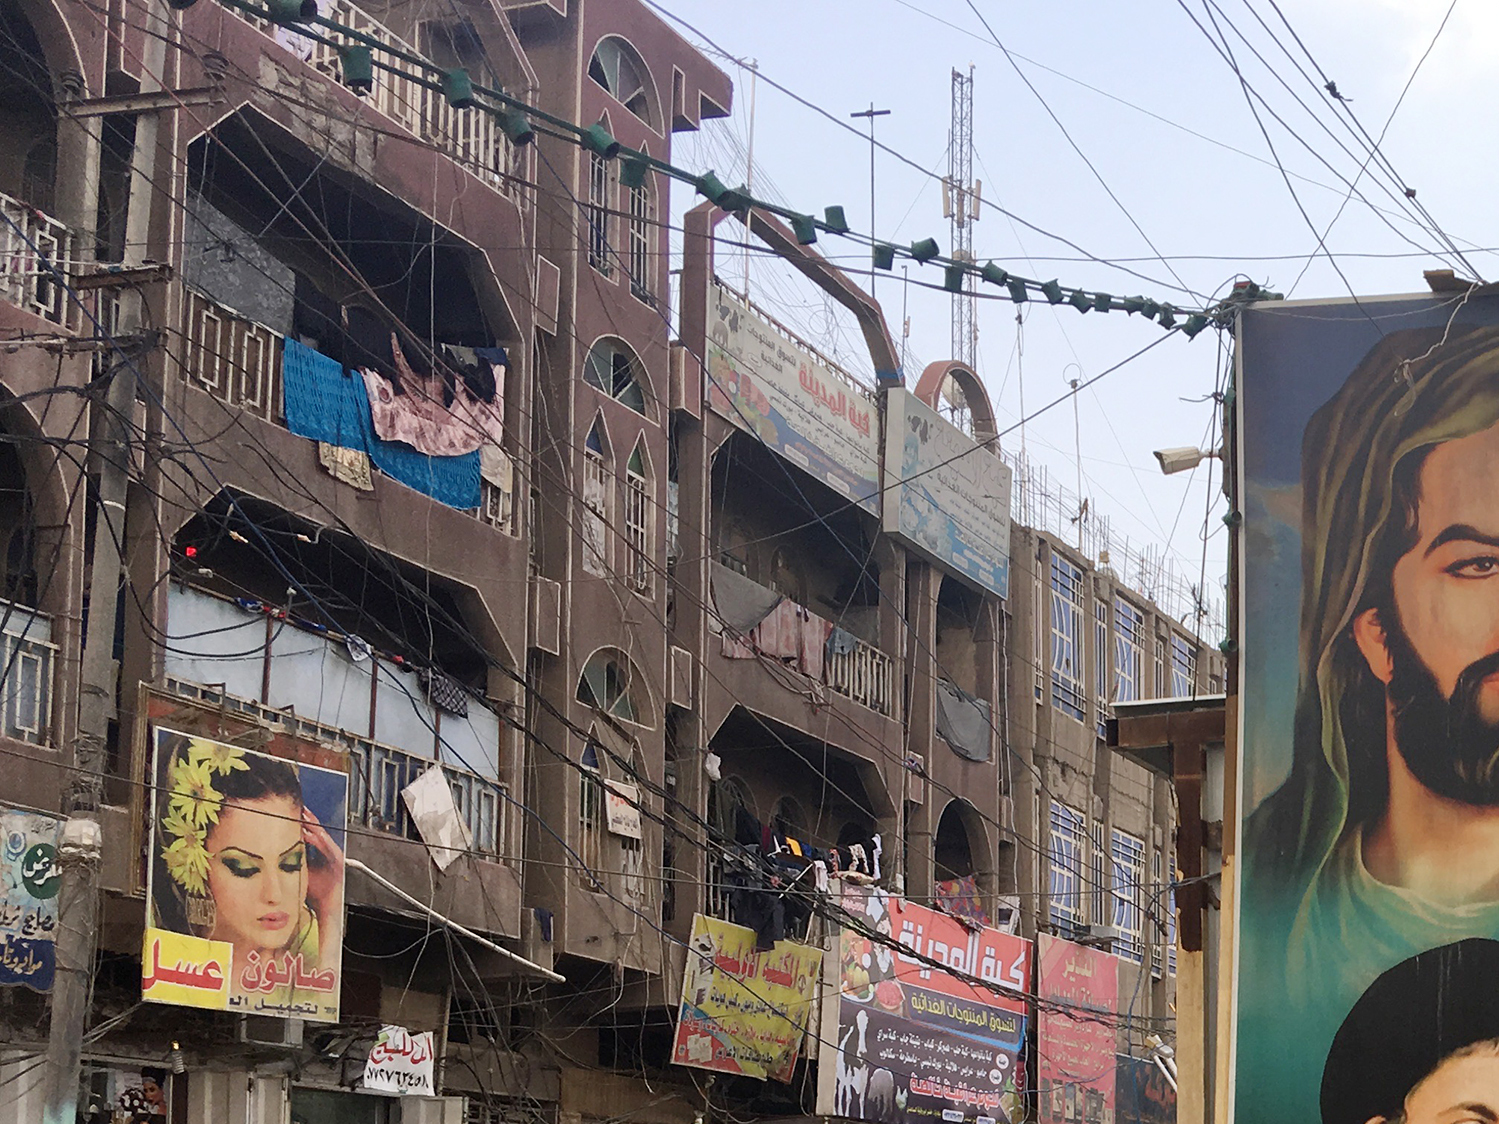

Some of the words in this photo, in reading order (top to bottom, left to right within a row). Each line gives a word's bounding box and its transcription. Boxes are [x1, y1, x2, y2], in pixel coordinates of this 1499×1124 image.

[142, 938, 224, 992] عسل
[240, 950, 337, 994] صالون
[898, 920, 981, 980] المدينة
[980, 946, 1026, 1000] كبة
